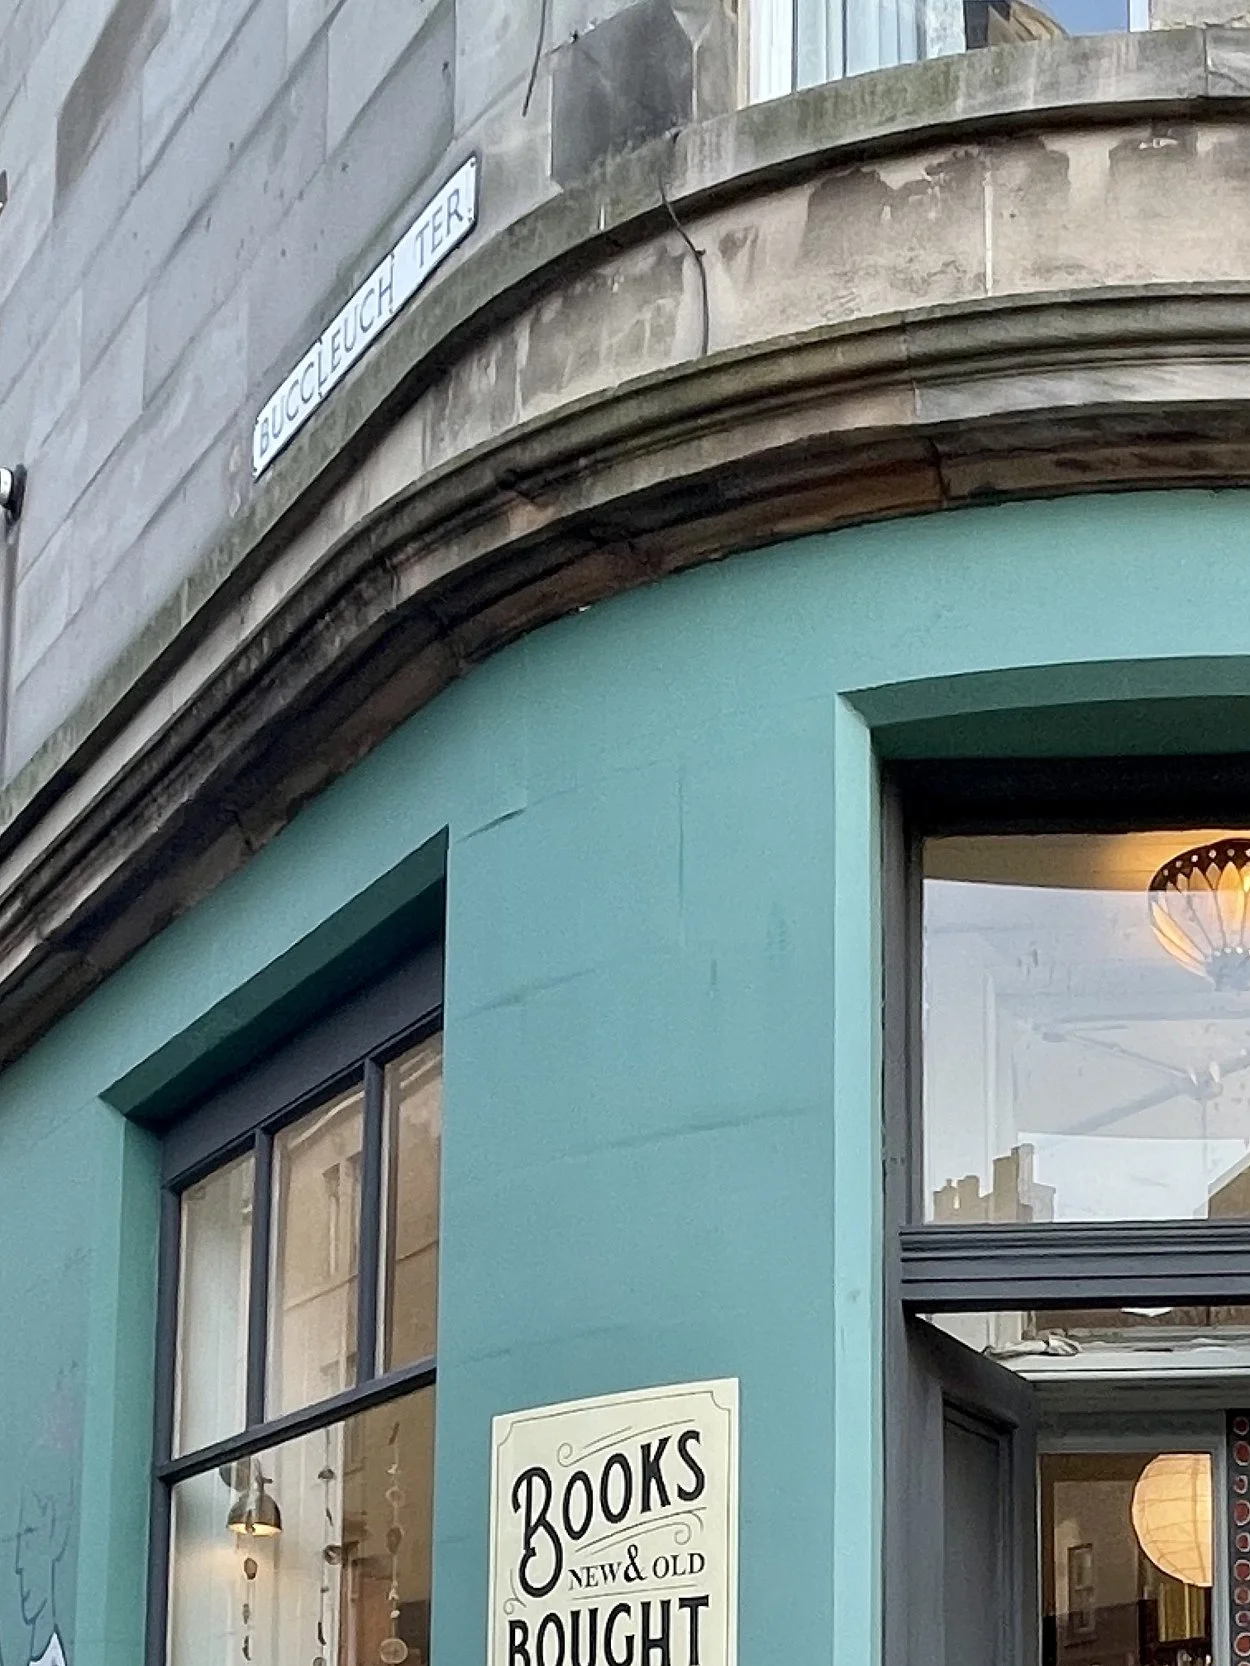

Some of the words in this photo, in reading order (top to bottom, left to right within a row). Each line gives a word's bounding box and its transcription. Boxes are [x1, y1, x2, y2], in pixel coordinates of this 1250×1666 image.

[257, 262, 395, 456] BUCCLEUCH
[414, 188, 464, 269] TER
[511, 1429, 707, 1599] BOOKS
[567, 1560, 622, 1592] NEW
[652, 1552, 706, 1578] OLD
